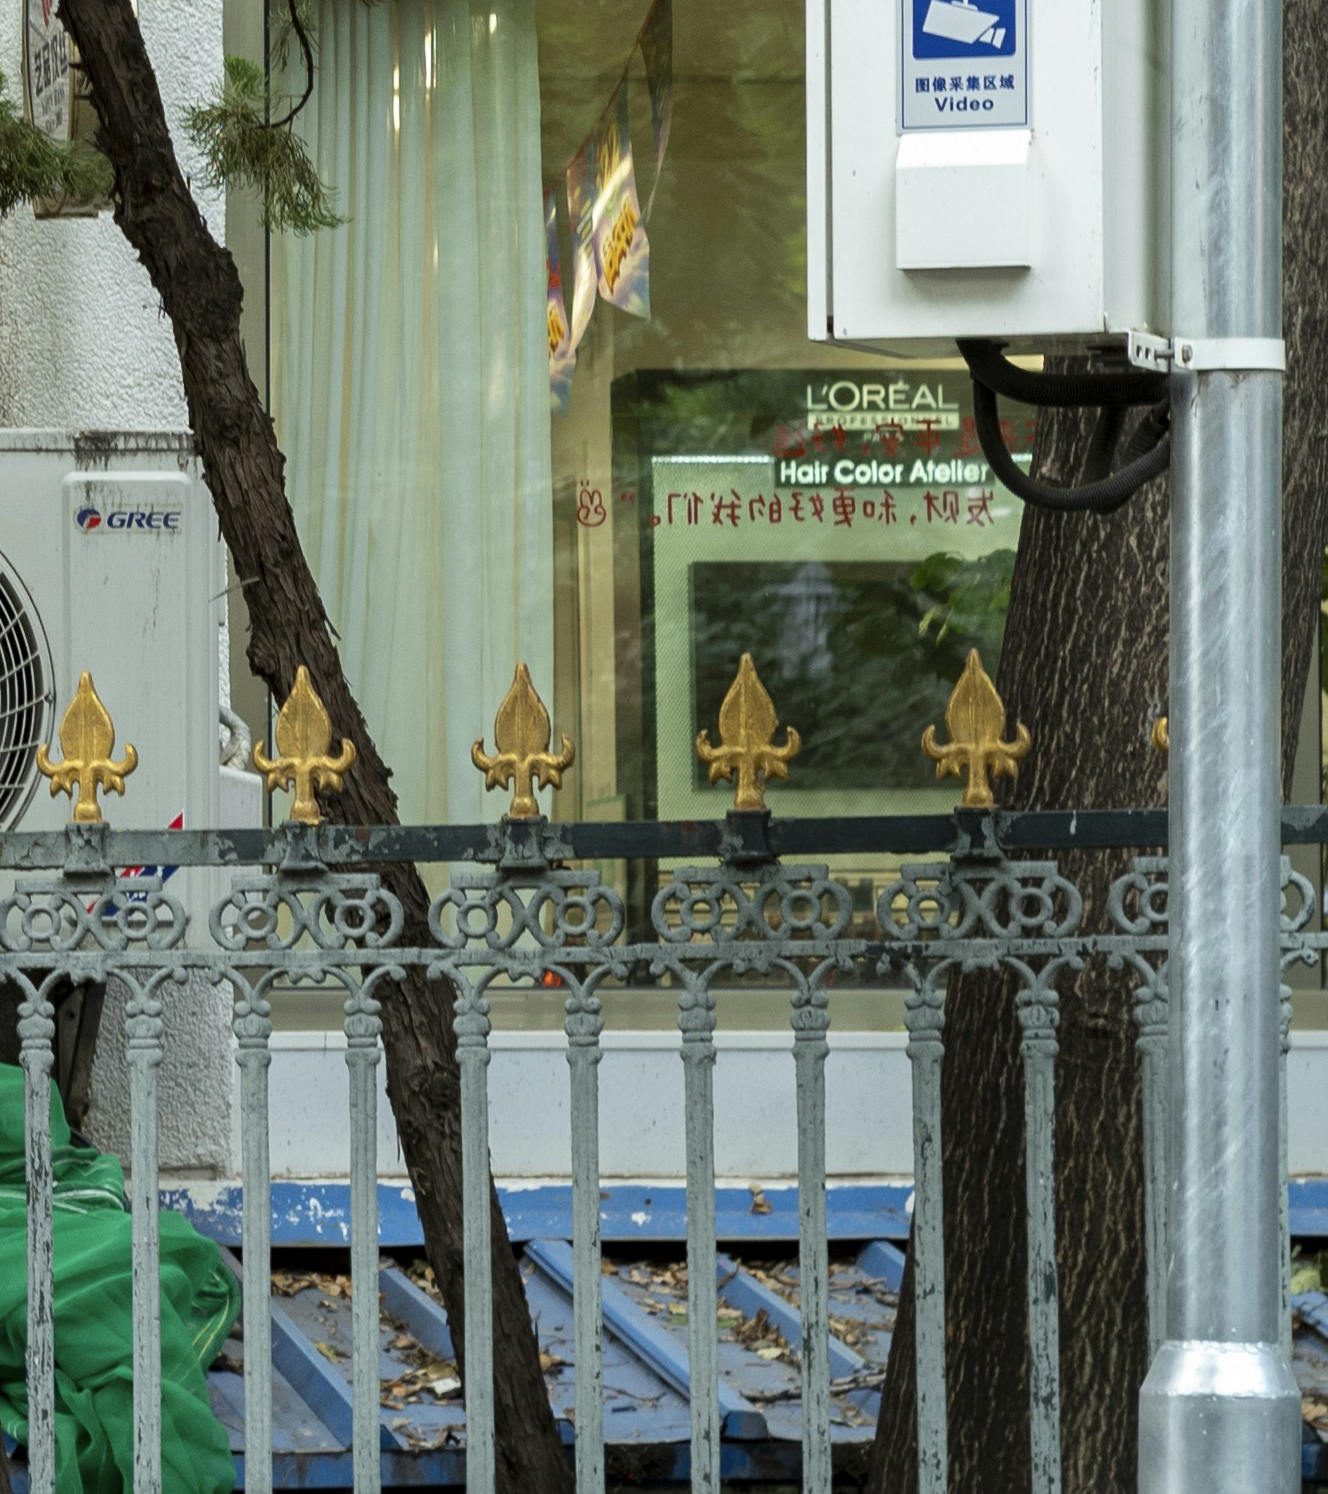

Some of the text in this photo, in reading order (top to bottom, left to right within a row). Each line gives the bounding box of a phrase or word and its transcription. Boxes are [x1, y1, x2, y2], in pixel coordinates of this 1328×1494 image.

[915, 74, 1015, 93] 图像采集区域
[934, 96, 994, 112] Video
[806, 380, 960, 411] L'ORÉAL
[780, 459, 989, 485] Hair Color Atelier
[106, 512, 182, 529] GREE
